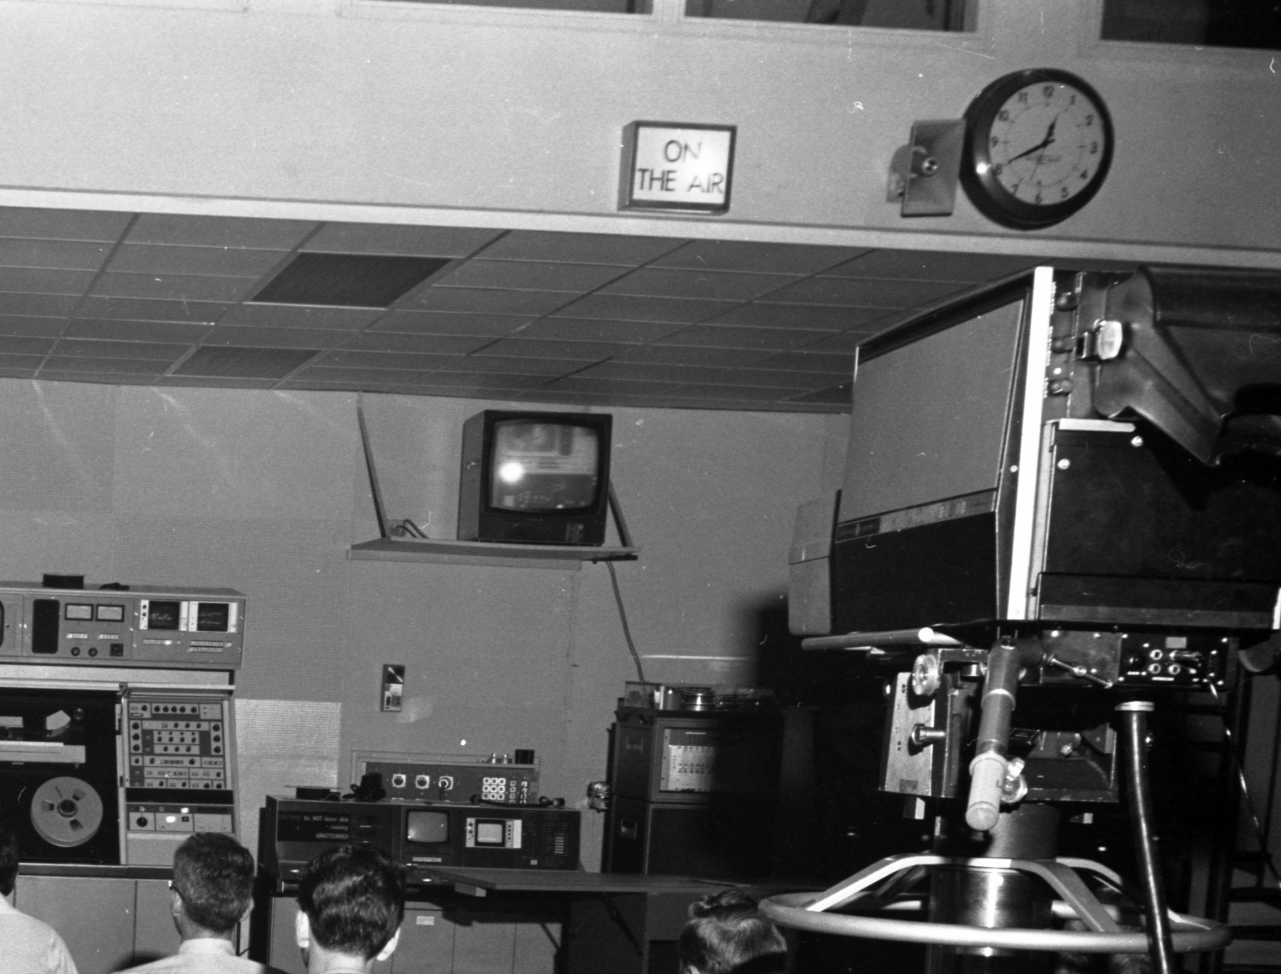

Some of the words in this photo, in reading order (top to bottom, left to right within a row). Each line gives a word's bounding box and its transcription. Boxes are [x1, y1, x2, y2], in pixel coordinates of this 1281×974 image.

[1018, 91, 1029, 103] 11
[1043, 85, 1055, 98] 12
[998, 109, 1010, 122] 10
[1085, 114, 1094, 127] 2
[991, 135, 999, 148] 9
[1089, 141, 1099, 155] 3
[664, 139, 702, 163] ON
[995, 163, 1003, 176] 8
[1079, 168, 1089, 180] 4
[637, 168, 678, 192] THE
[687, 172, 724, 194] AIR
[1061, 186, 1070, 198] 5
[1035, 193, 1043, 205] 6
